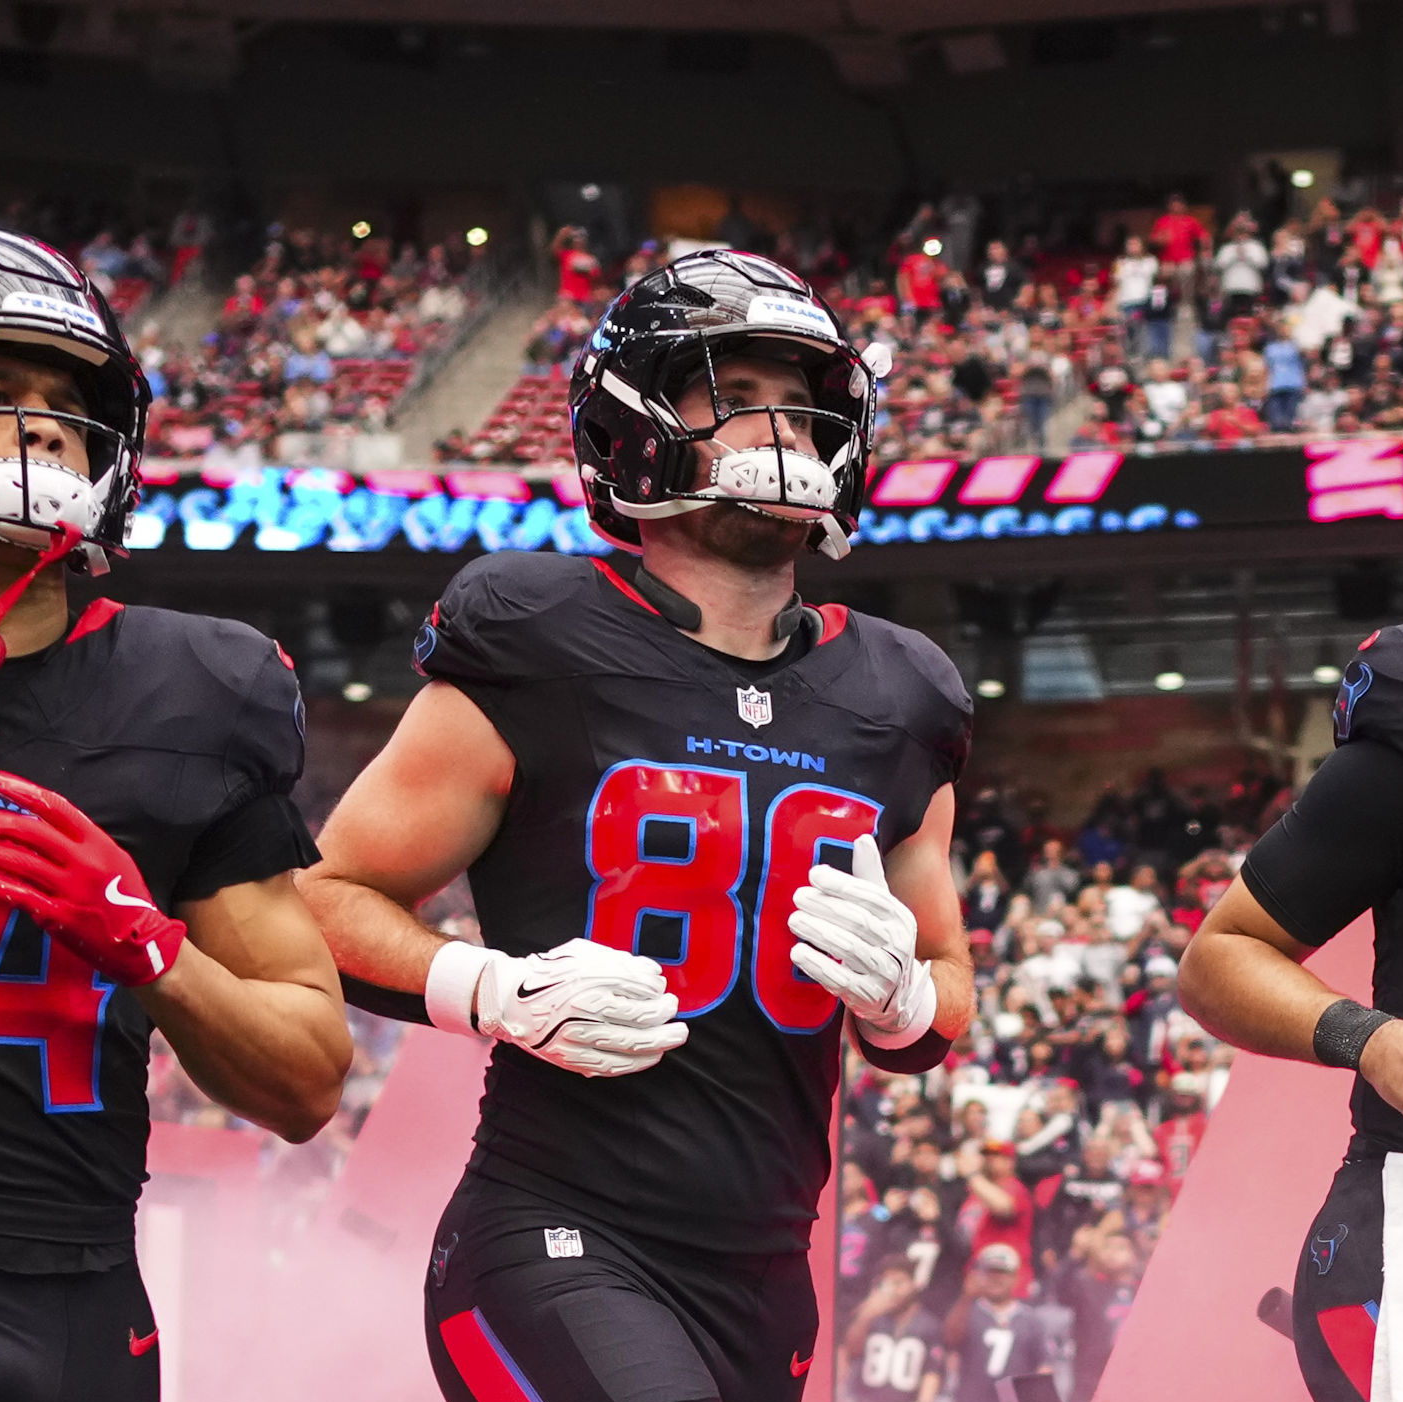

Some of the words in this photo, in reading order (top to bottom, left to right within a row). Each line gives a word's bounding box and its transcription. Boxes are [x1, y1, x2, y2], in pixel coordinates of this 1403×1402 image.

[16, 297, 95, 325] TEXANS
[763, 302, 826, 323] TEXANS
[744, 703, 767, 719] NFL
[686, 736, 825, 773] H-TOWN
[552, 1241, 577, 1255] NFL
